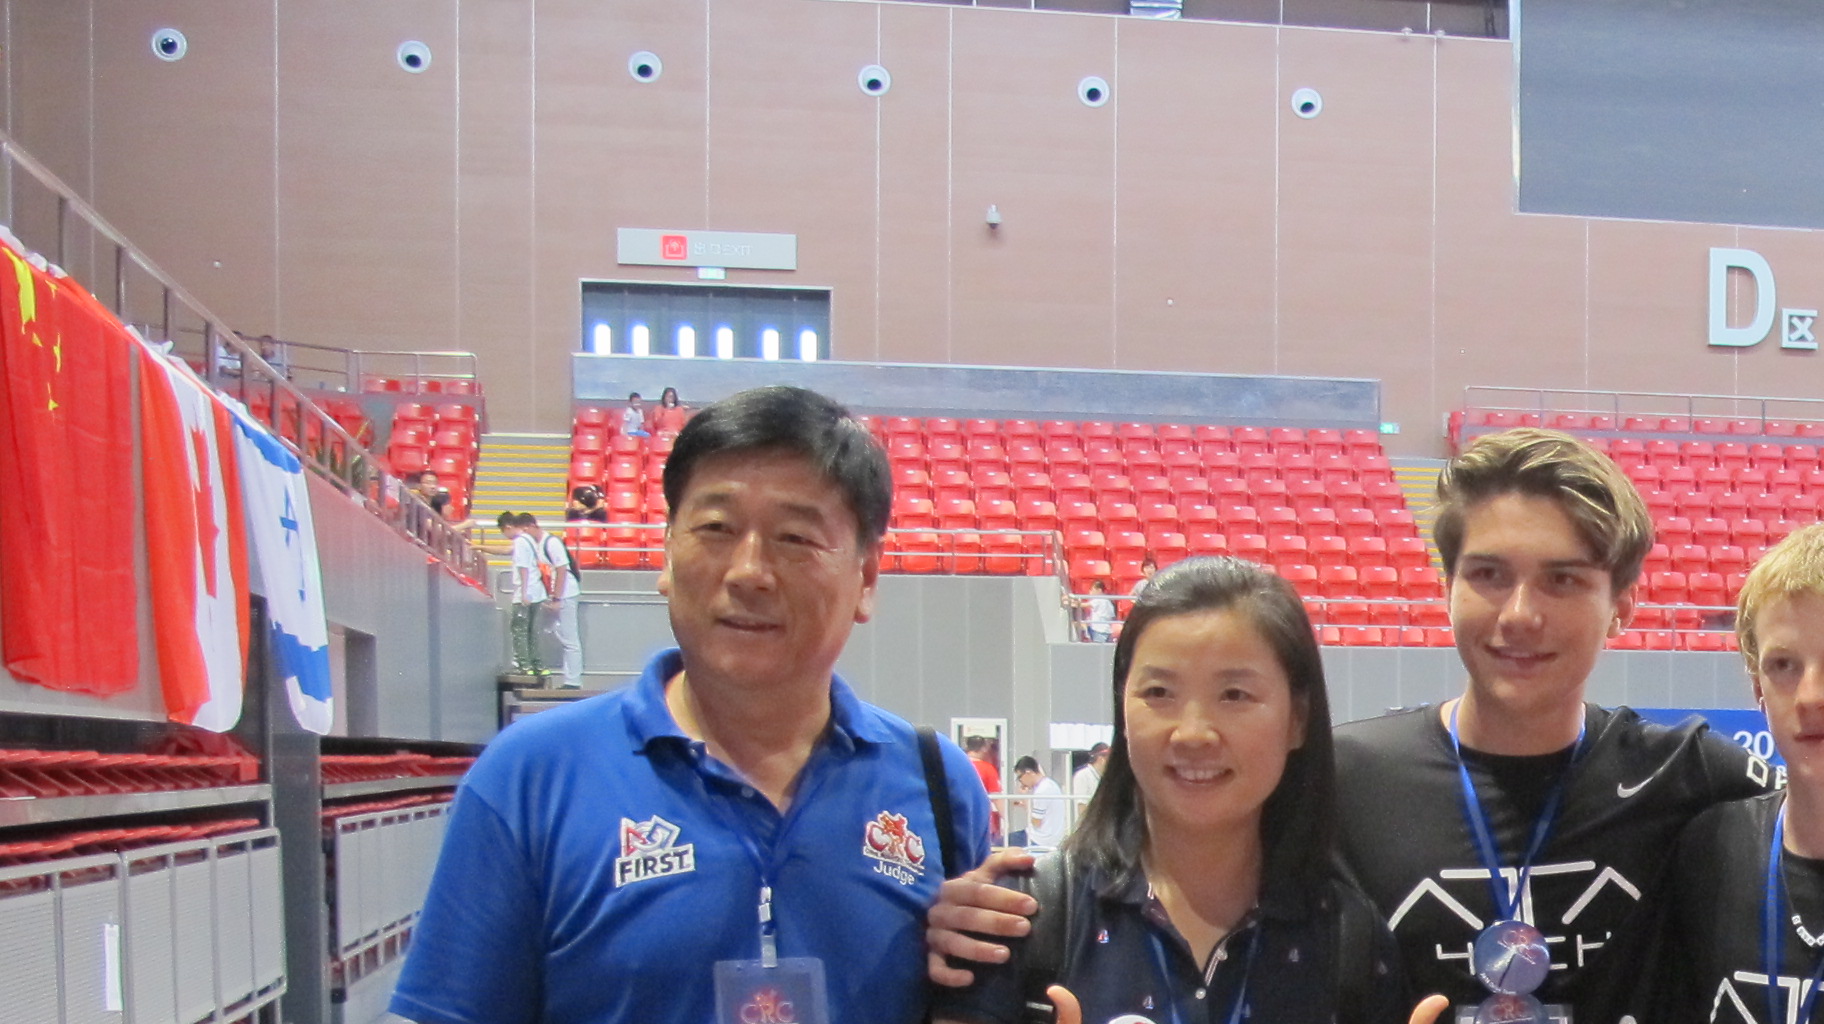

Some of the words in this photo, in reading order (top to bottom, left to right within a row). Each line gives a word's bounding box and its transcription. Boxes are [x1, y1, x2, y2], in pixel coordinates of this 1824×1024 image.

[619, 849, 690, 883] FIRST
[873, 860, 916, 886] Judge
[741, 1000, 795, 1024] CRC
